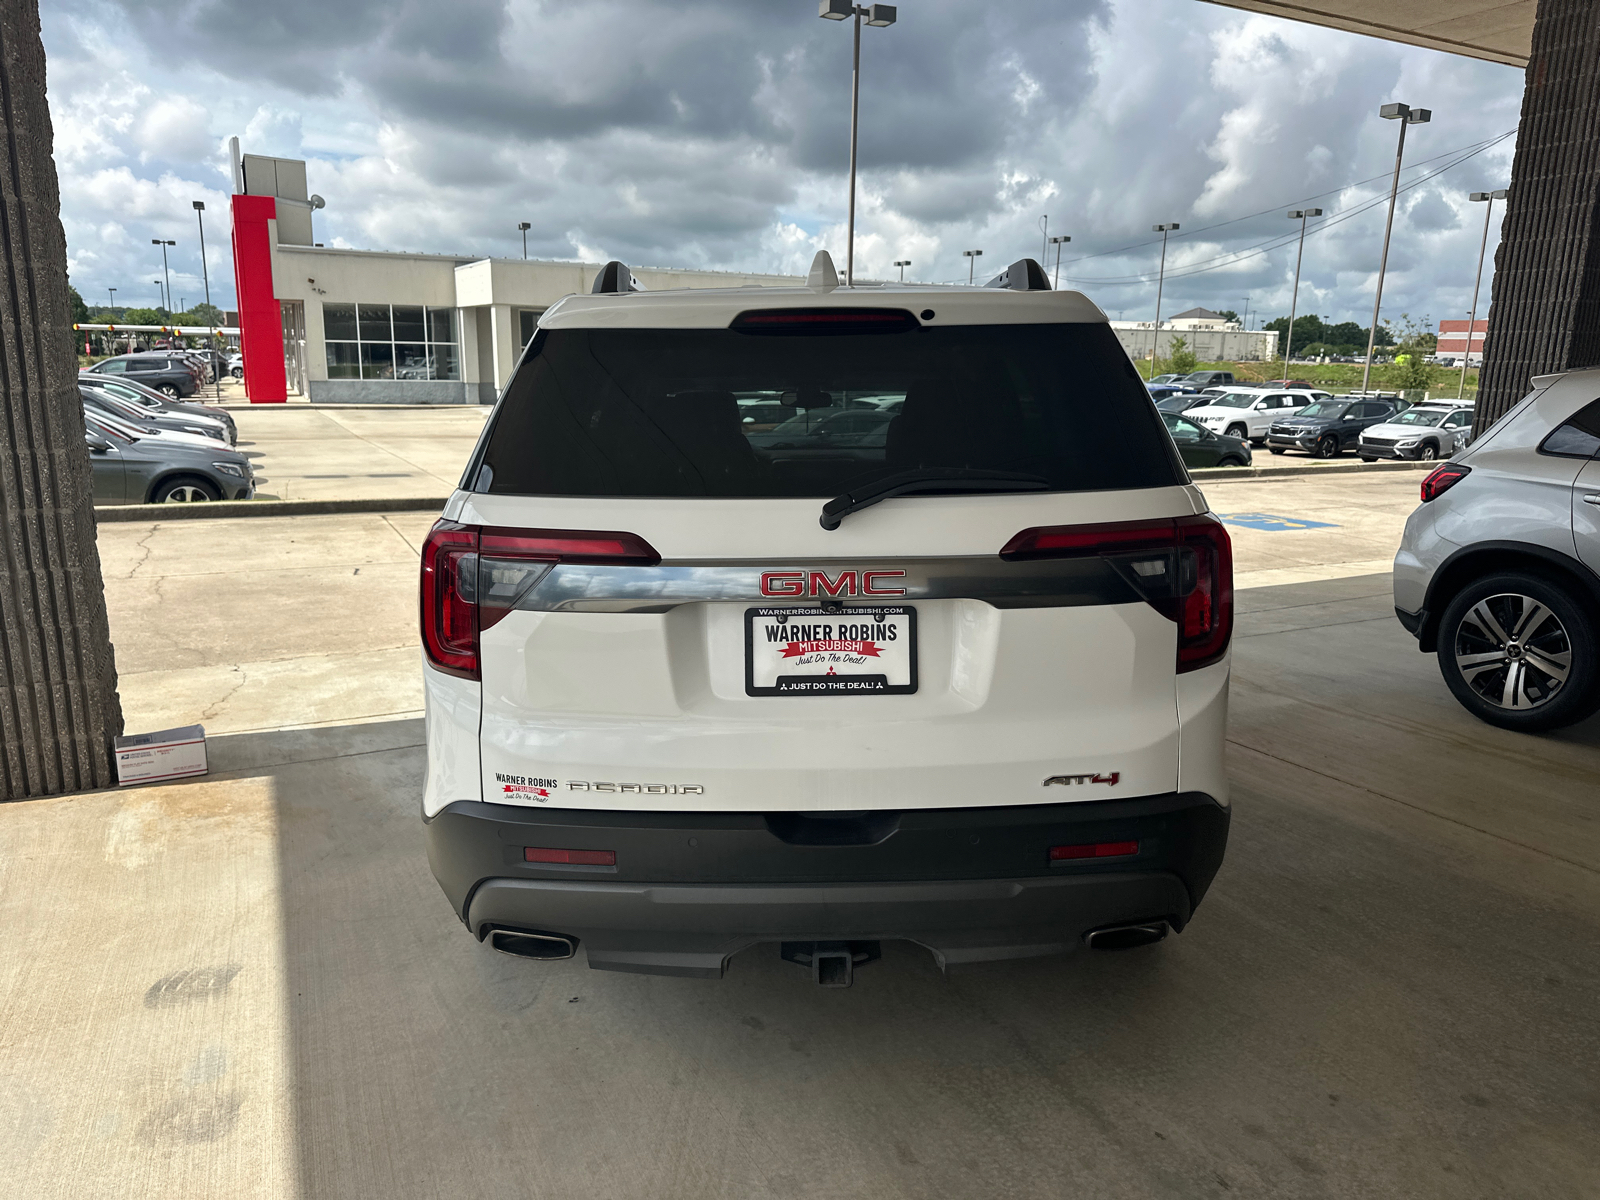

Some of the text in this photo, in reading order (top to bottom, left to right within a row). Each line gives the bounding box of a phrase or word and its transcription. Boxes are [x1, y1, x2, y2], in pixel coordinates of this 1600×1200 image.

[760, 570, 906, 598] GMC
[765, 624, 897, 642] WARNER ROBINS
[799, 641, 863, 652] MITSUBISHI
[795, 653, 867, 666] Just Do The Deal!
[495, 772, 558, 788] WARNER ROBINS
[1041, 771, 1120, 786] AT4
[565, 779, 704, 795] ACADIA
